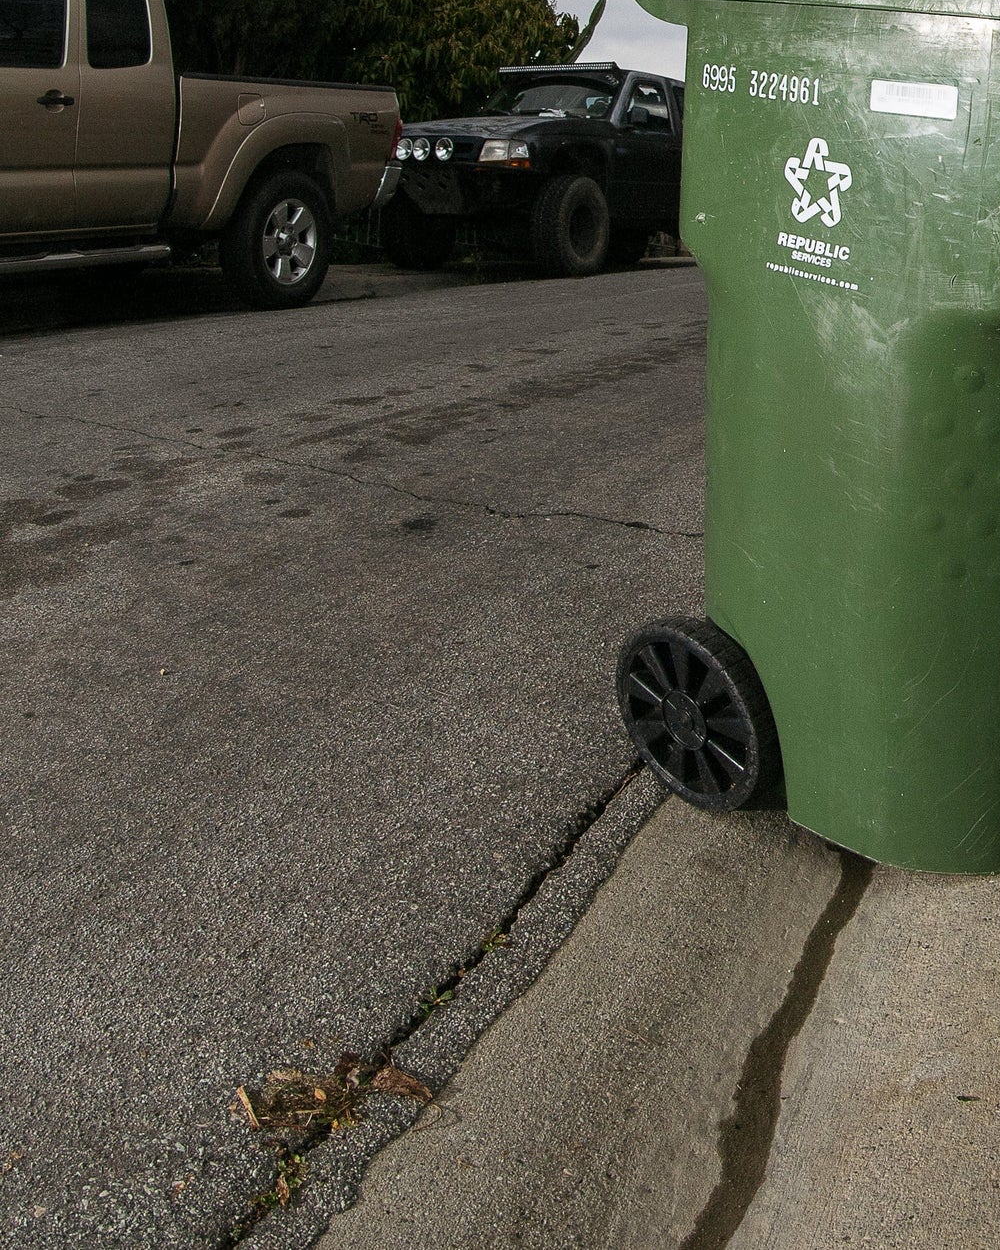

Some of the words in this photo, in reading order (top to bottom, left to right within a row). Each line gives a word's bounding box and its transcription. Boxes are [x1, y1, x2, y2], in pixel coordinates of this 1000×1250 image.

[702, 64, 736, 92] 6995
[750, 70, 819, 105] 3224961
[778, 232, 850, 260] REPUBLIC
[791, 251, 831, 267] SERVICES
[766, 262, 858, 290] republicservices.com
